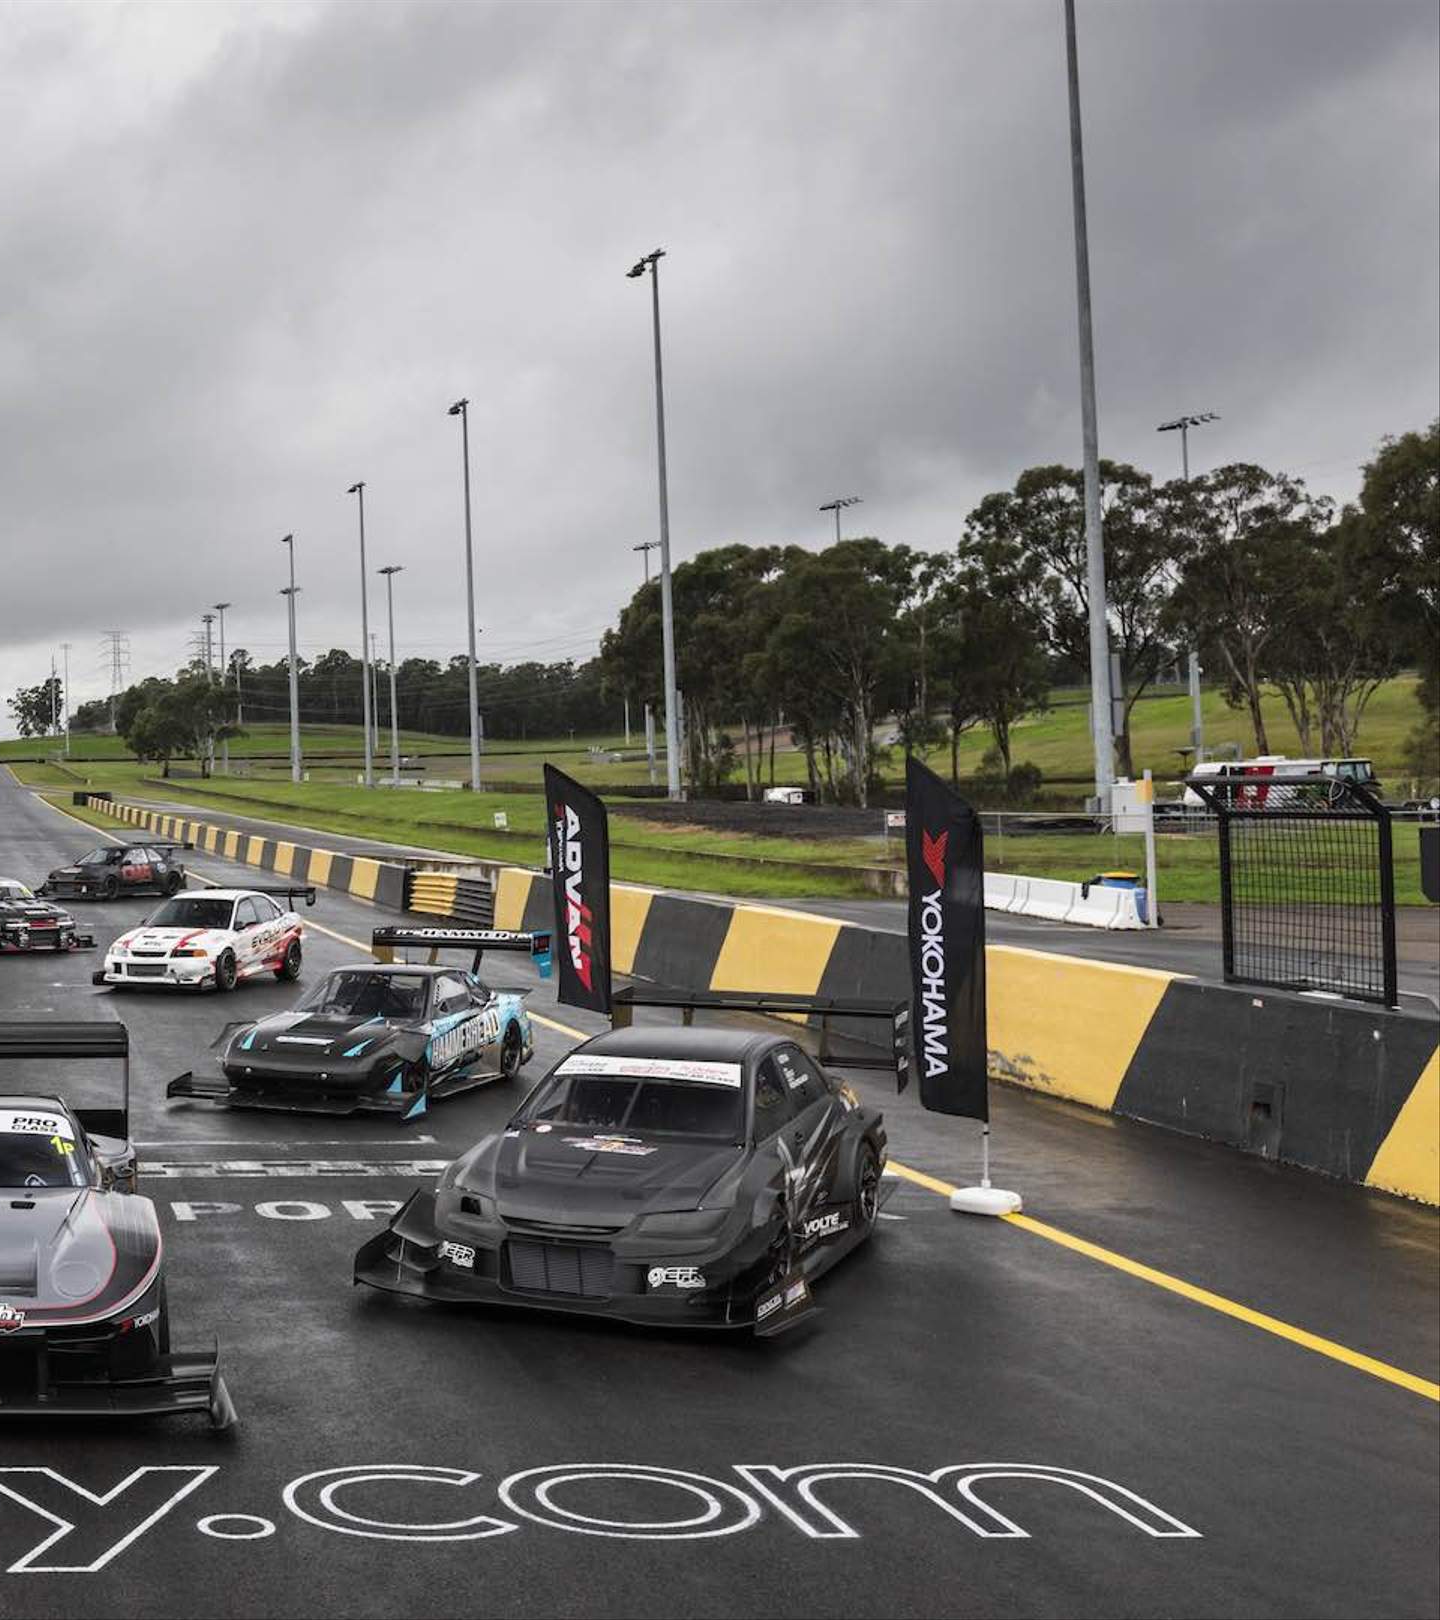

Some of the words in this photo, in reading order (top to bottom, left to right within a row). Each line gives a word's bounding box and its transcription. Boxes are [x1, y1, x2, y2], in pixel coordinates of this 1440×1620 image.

[921, 889, 949, 1079] YOKOHAMA
[11, 1125, 60, 1134] CLASS
[12, 1117, 58, 1127] PRO
[803, 1211, 840, 1234] VOLTE
